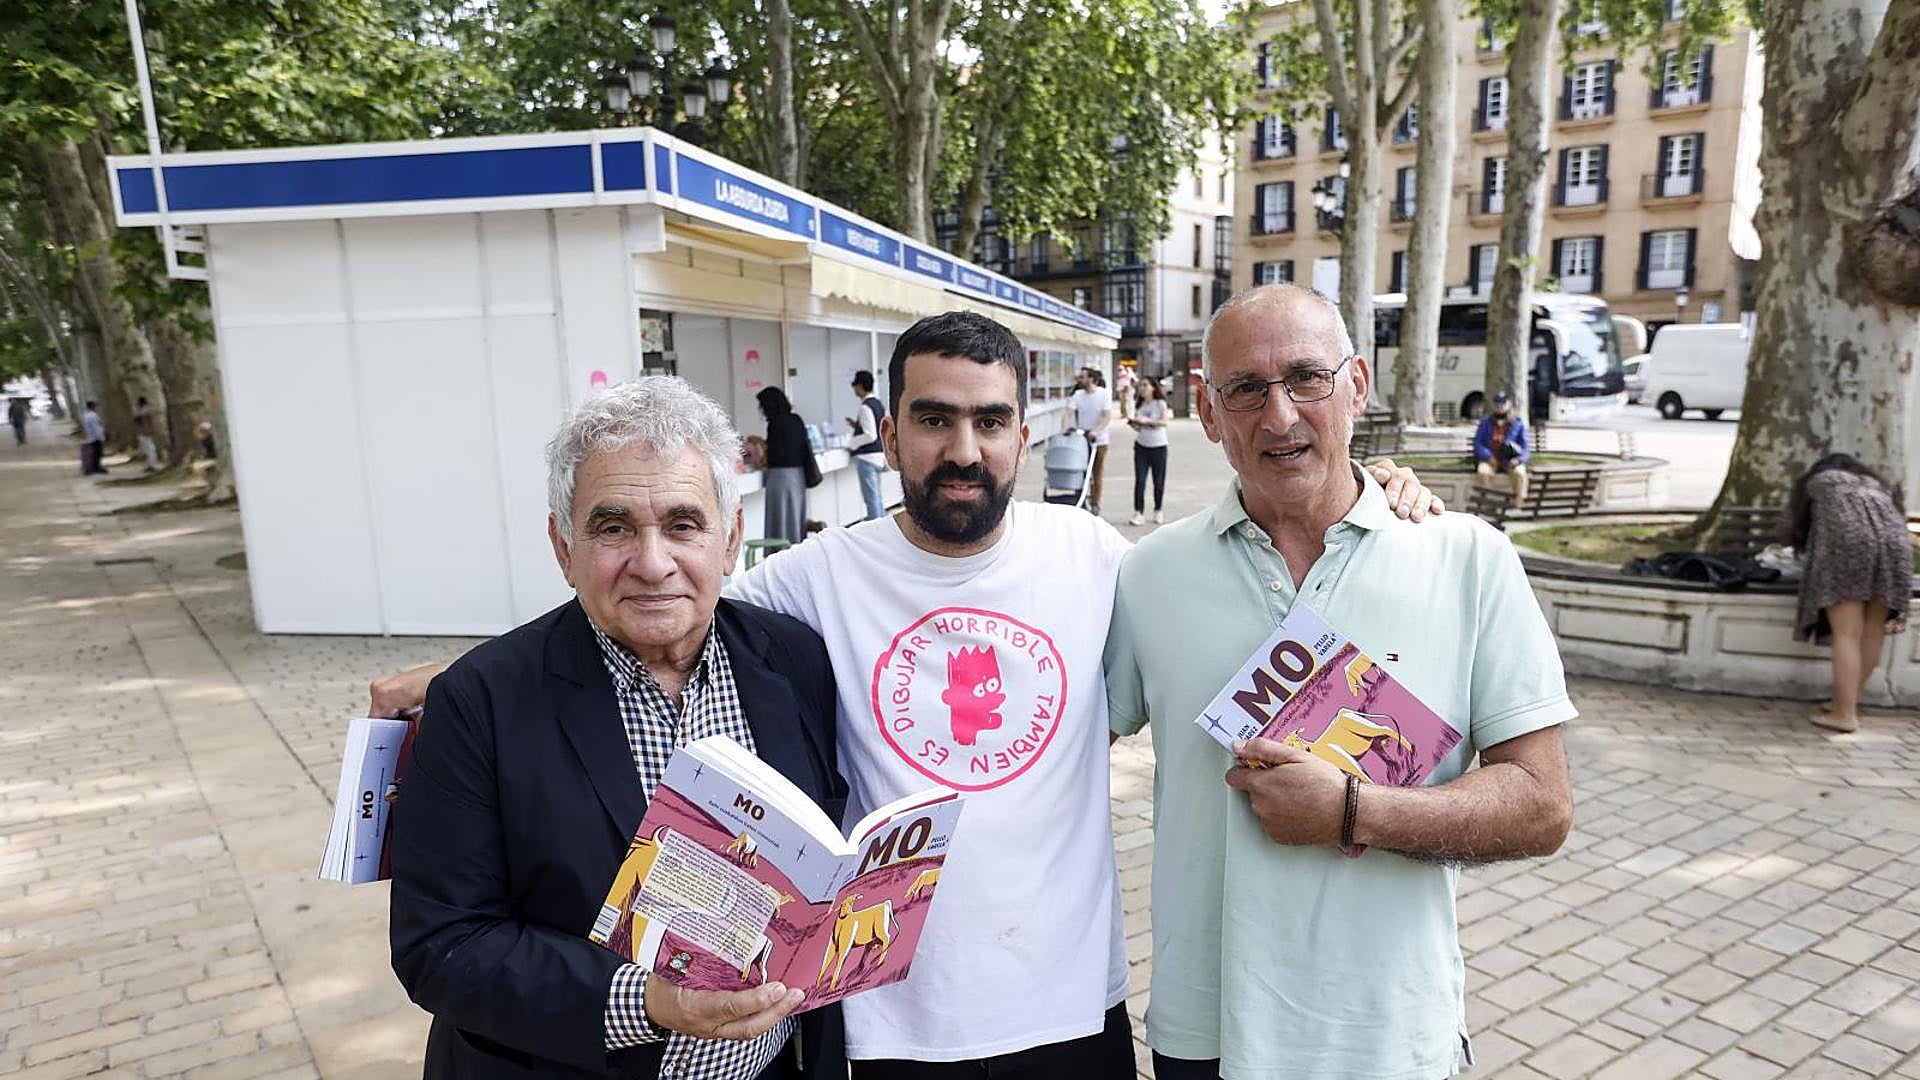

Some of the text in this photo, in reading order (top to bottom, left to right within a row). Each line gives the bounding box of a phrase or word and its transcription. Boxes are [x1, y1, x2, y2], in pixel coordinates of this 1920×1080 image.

[893, 616, 1054, 774] DIBUJAR HORRIBLE TAMBIEN ES
[1231, 639, 1315, 727] MO
[362, 790, 374, 819] MO
[733, 793, 765, 821] MO
[856, 816, 932, 877] MO
